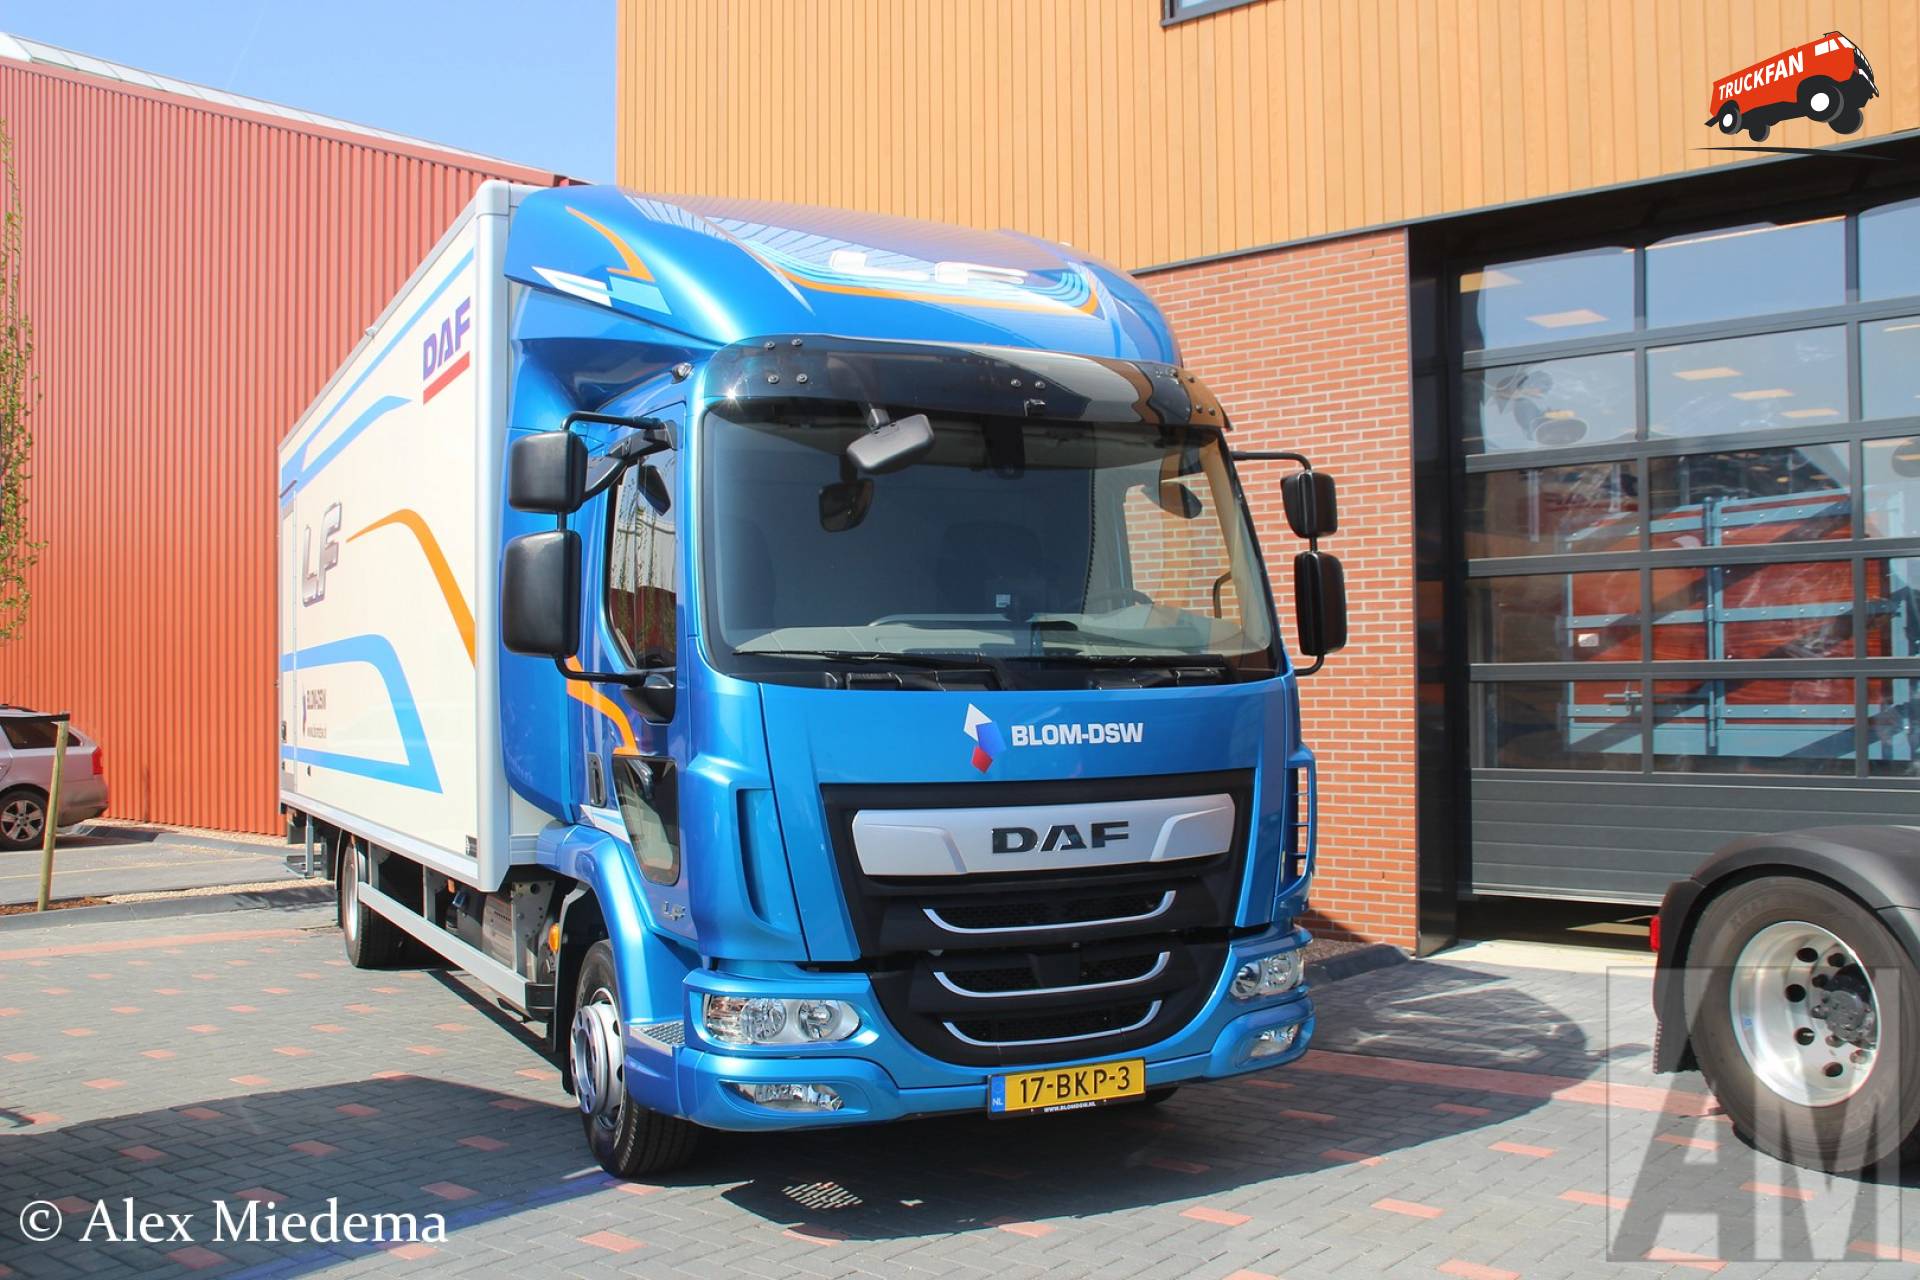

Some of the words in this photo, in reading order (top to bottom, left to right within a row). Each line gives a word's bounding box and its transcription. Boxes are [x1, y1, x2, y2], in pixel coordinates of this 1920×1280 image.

[422, 296, 471, 381] DAF
[302, 501, 342, 608] LF
[1011, 722, 1144, 747] BLOM-DSW
[992, 820, 1130, 854] DAF
[992, 1096, 1004, 1107] NL
[1019, 1066, 1130, 1104] 17-BKP-3
